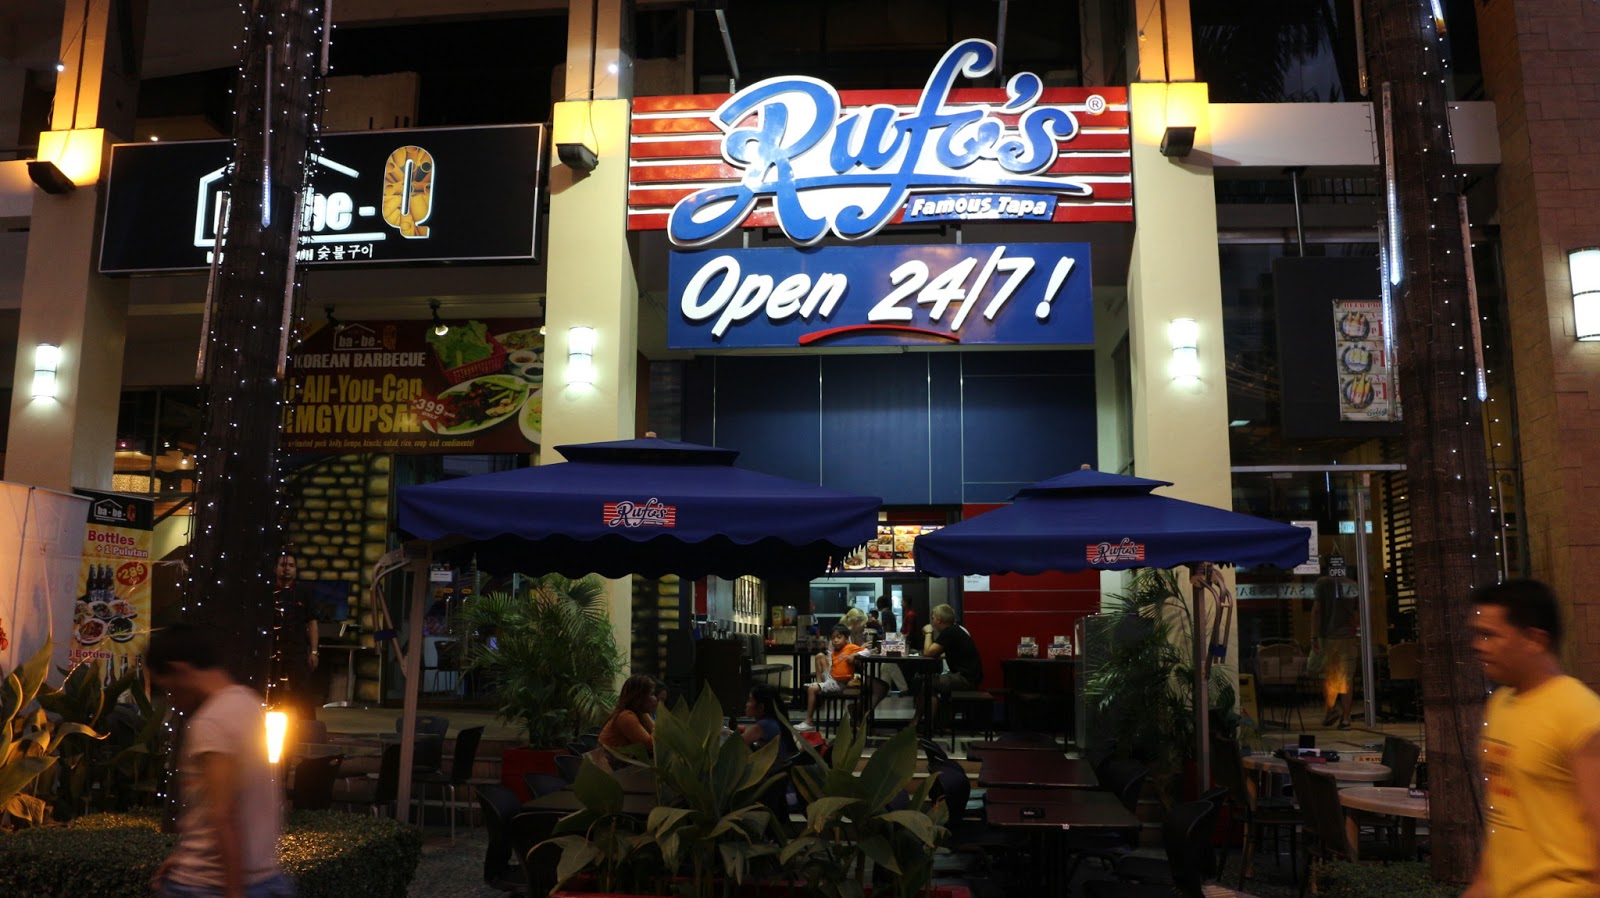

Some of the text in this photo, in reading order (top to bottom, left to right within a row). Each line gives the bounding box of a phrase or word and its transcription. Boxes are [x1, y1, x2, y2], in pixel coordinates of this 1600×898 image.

[668, 38, 1092, 247] Rufo's
[910, 196, 1048, 217] Famous Tapa
[680, 254, 848, 338] Open
[868, 245, 1036, 332] 24/7
[353, 352, 426, 368] BARBECUE
[281, 373, 423, 404] t-All-You-Can
[281, 403, 421, 433] MGYUPSAL
[608, 497, 669, 528] Rufo's
[88, 530, 135, 546] Bottles
[1091, 537, 1140, 565] Rufo's
[113, 546, 149, 559] Pulutan
[1329, 568, 1347, 577] OPEN
